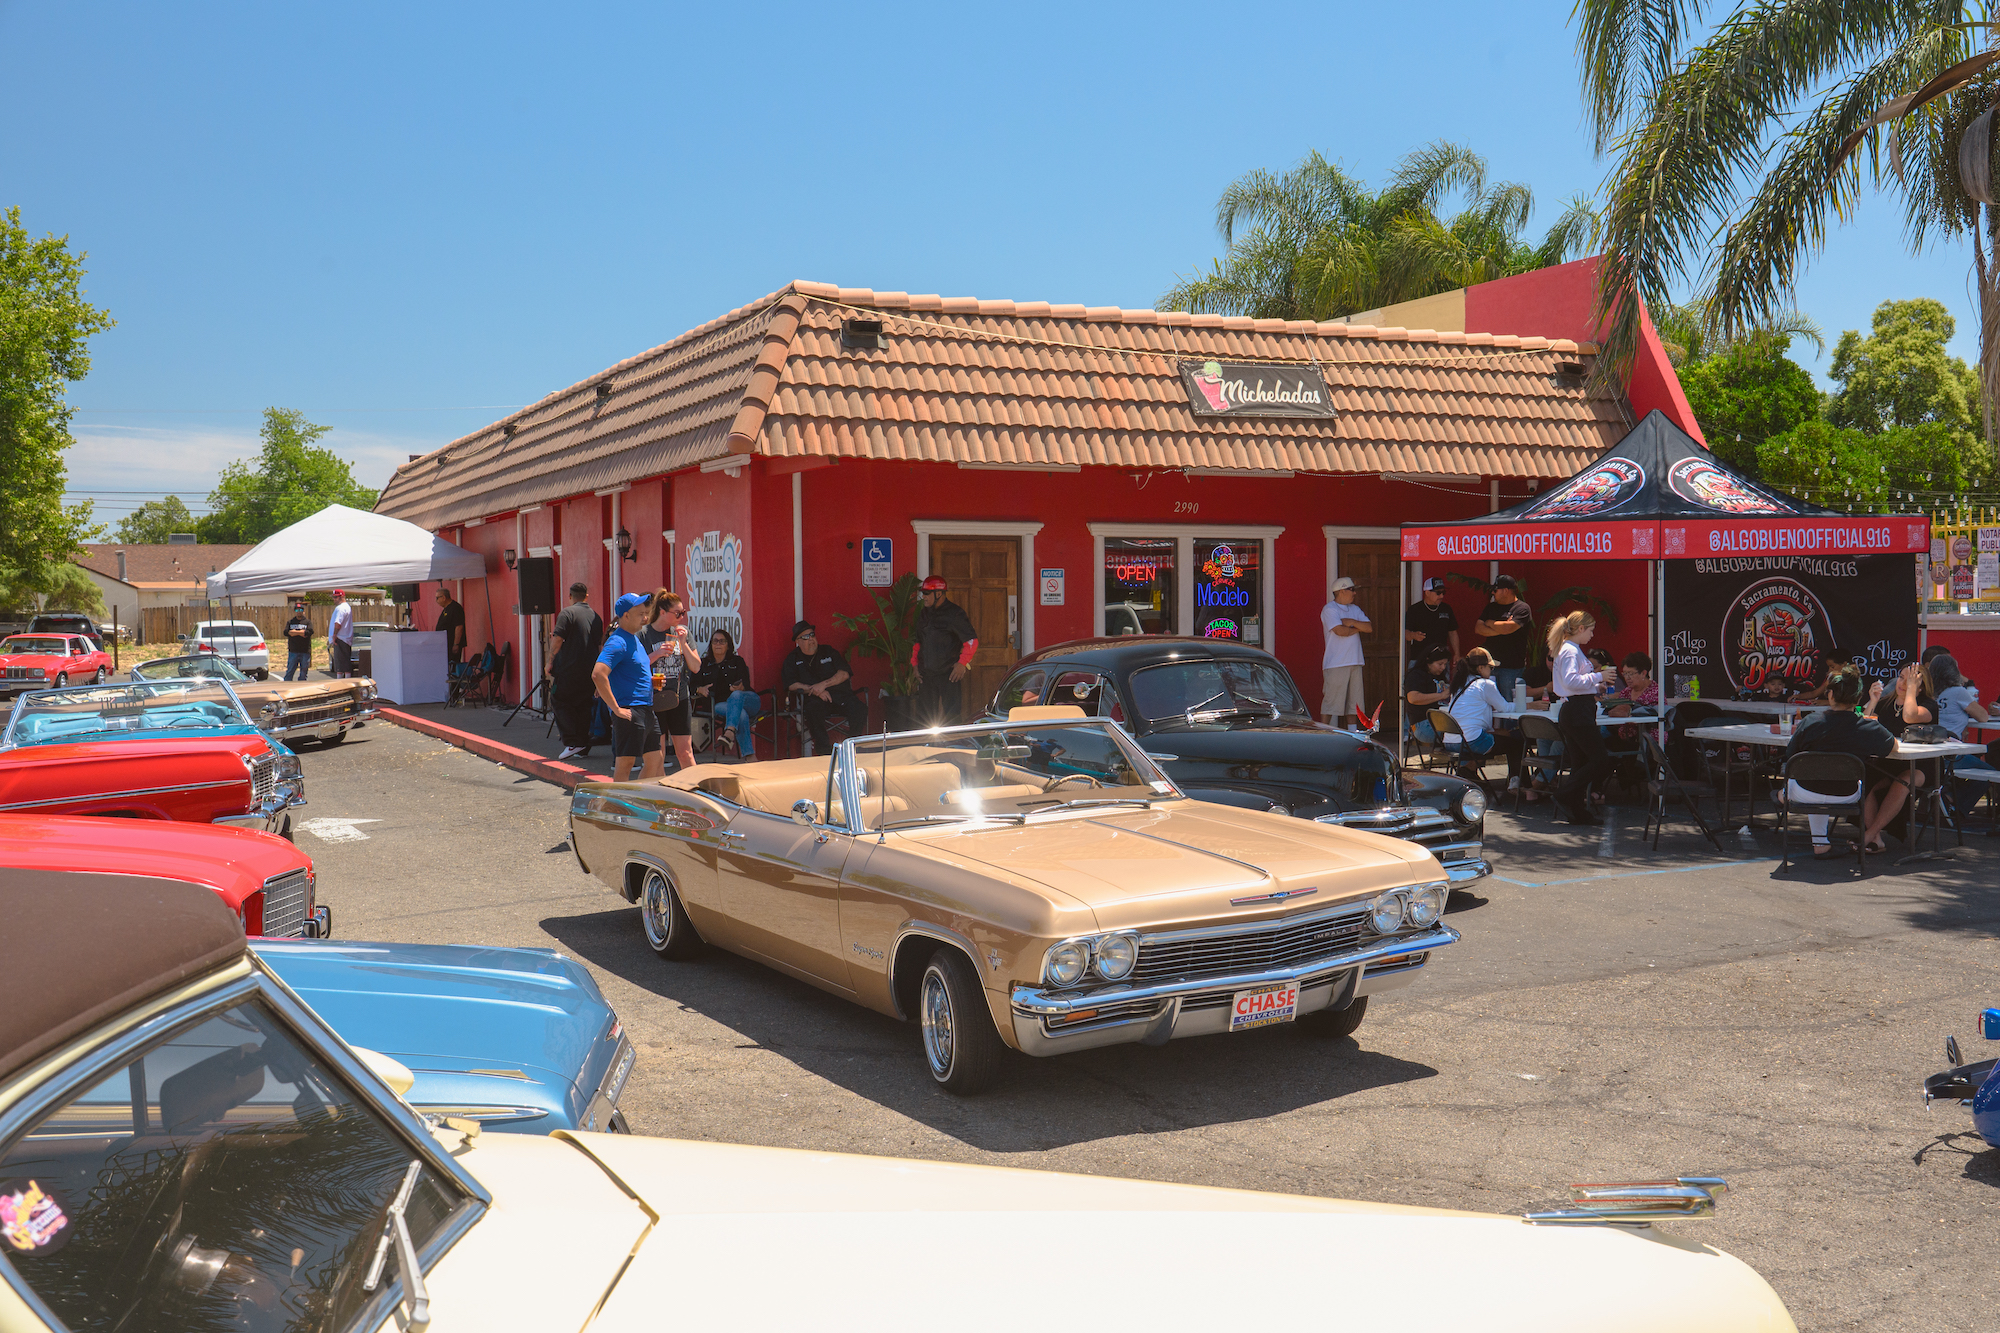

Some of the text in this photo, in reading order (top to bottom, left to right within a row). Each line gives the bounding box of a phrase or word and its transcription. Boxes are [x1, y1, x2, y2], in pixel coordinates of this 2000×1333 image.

[1204, 379, 1321, 404] Micheladas
[1174, 501, 1199, 514] 2990
[703, 534, 719, 552] ALL I
[1437, 532, 1613, 555] @ALGOBUENOOFFICIAL916
[1709, 527, 1891, 551] @ALGOBUENOOFFICIAL916
[702, 555, 723, 573] NEED IS
[1116, 565, 1156, 581] OPEN
[1936, 565, 1945, 577] R
[1211, 577, 1236, 588] CERVEZA
[695, 579, 731, 608] TACOS
[1197, 582, 1249, 607] Modelo
[1741, 585, 1800, 610] Sacramento,
[1209, 619, 1234, 631] TACOS
[1211, 629, 1231, 638] OPEN
[1671, 630, 1707, 655] Algo
[1767, 646, 1785, 655] ALGO
[1664, 645, 1708, 666] Bueno
[1867, 639, 1907, 667] Algo
[1250, 985, 1285, 995] CHASE
[1236, 988, 1296, 1015] CHASE
[1239, 1008, 1289, 1022] CHEVROLET
[1245, 1016, 1280, 1029] STOCKTON
